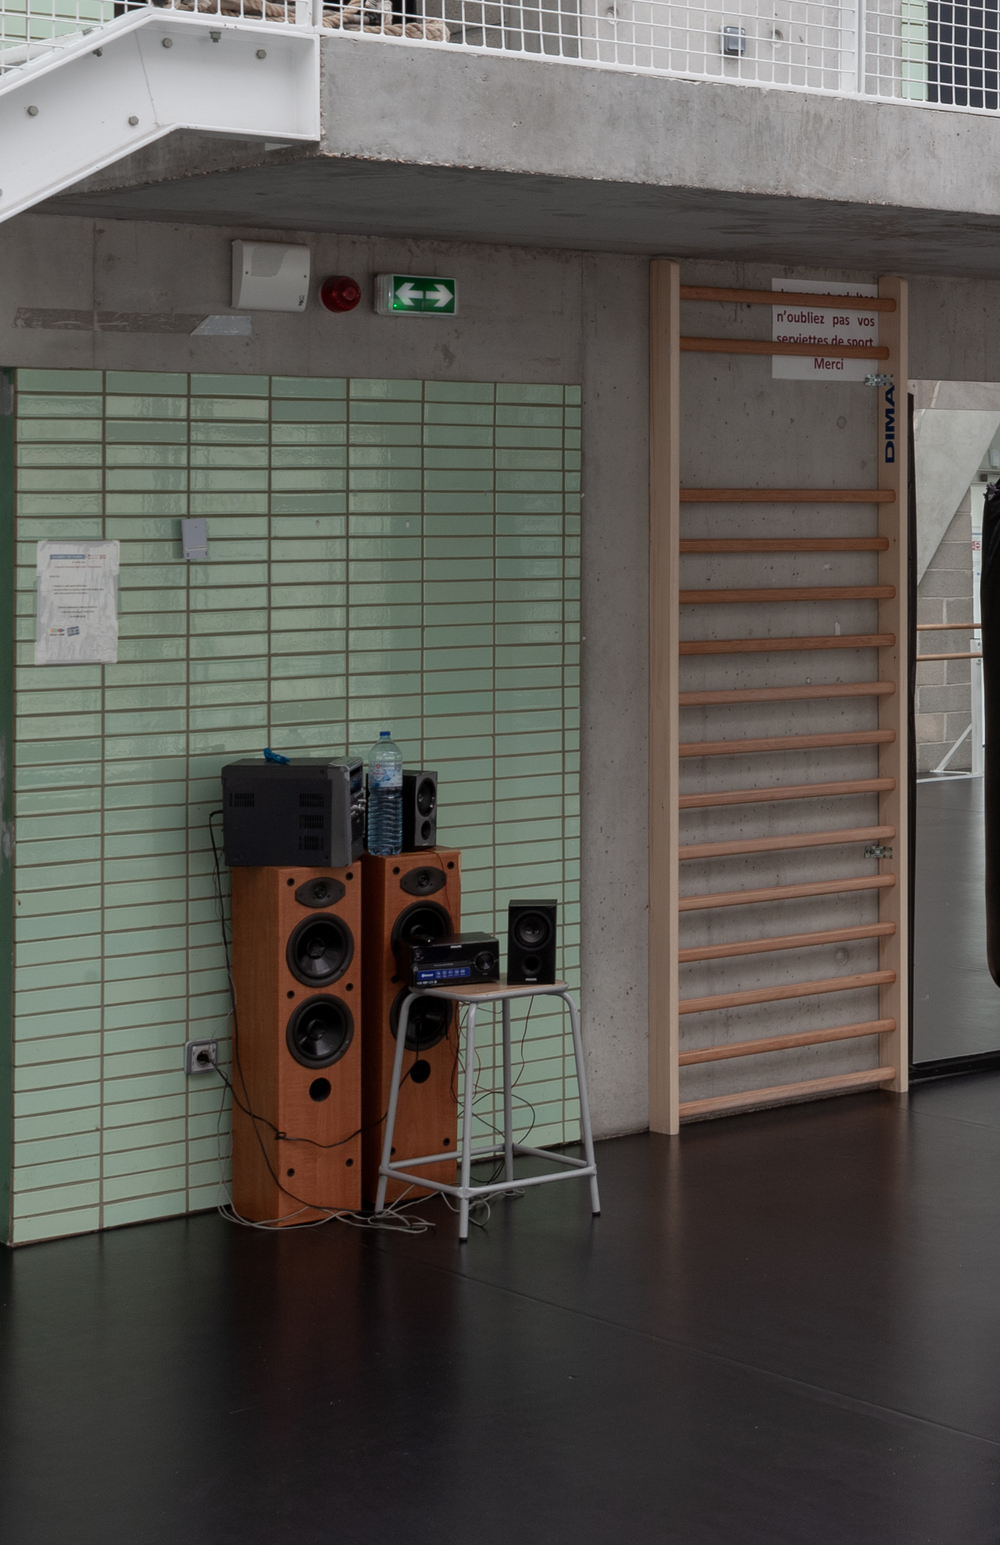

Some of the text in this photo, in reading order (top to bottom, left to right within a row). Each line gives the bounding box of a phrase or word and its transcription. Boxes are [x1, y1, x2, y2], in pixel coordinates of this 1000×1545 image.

[832, 316, 850, 328] pas
[857, 317, 875, 327] vos
[831, 335, 844, 346] de
[814, 358, 844, 370] Merci
[885, 385, 895, 463] DIMA
